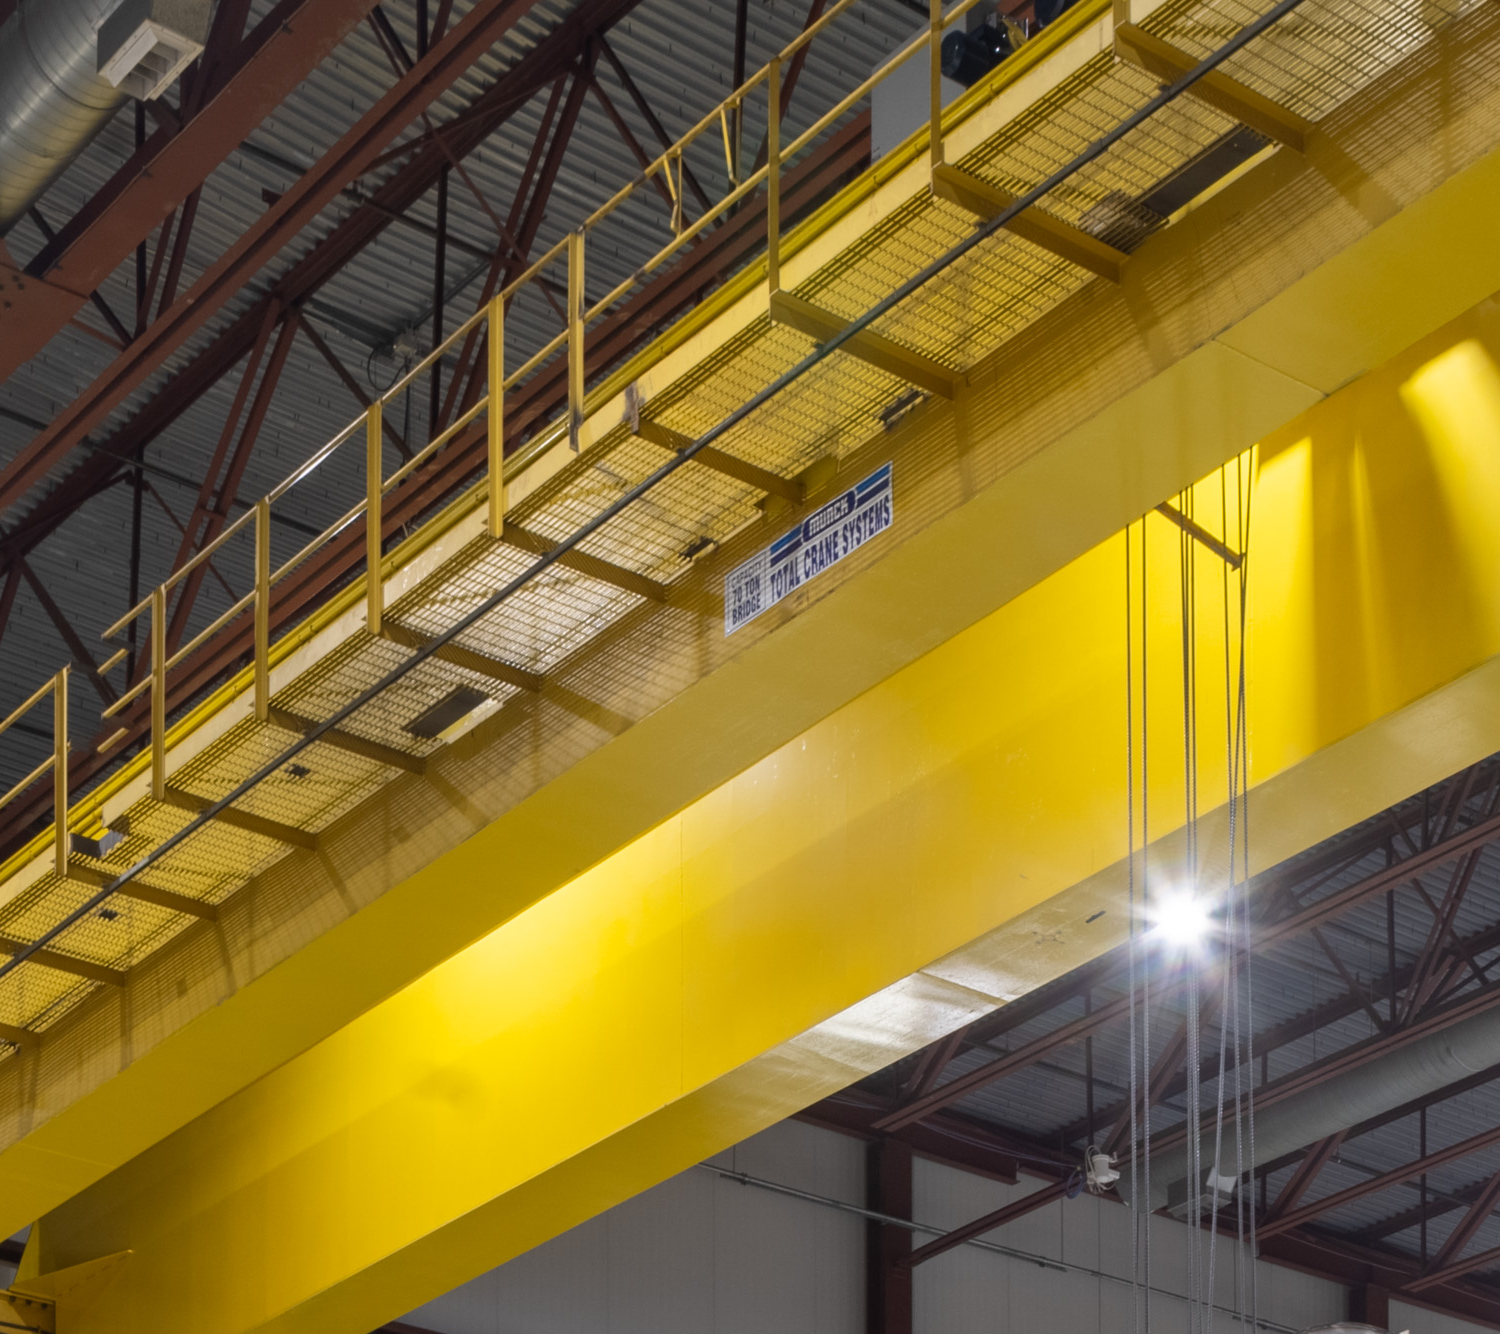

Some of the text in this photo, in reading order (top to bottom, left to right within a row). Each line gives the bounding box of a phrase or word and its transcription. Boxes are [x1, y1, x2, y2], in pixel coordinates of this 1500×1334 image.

[770, 495, 890, 602] TOTAL CRANE SYSTEMS
[731, 560, 762, 588] CAPACITY
[732, 576, 760, 604] 70 TON
[732, 593, 761, 626] BRIDGE
